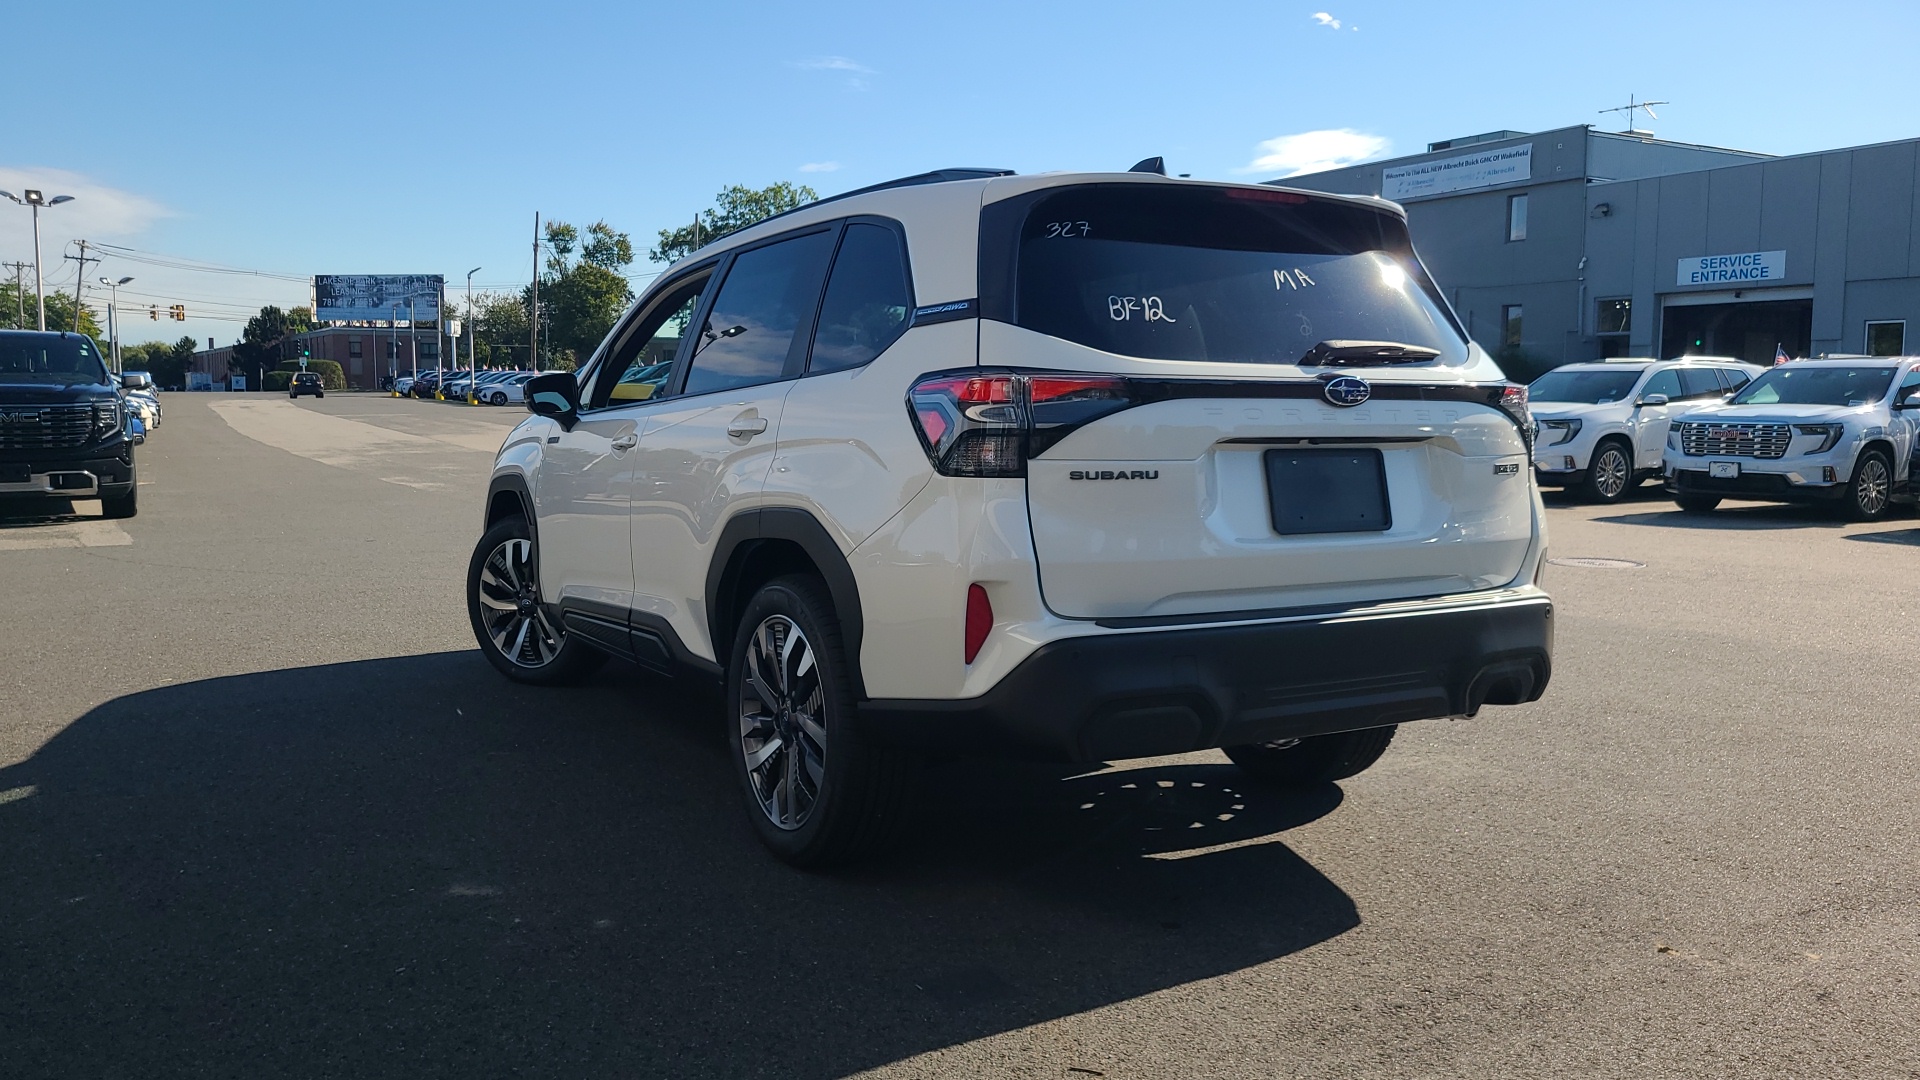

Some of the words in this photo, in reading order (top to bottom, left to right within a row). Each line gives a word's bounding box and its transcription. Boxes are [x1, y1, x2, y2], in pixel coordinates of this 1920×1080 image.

[1430, 164, 1443, 172] NEW
[1442, 162, 1464, 171] Albrecht
[1465, 158, 1479, 167] Buick
[1480, 155, 1493, 164] GMC
[1500, 149, 1529, 160] Wakefield
[1487, 166, 1515, 176] Albrecht
[1045, 221, 1092, 239] 327
[1700, 254, 1762, 269] SERVICE
[1274, 268, 1315, 290] MA
[1691, 266, 1769, 282] ENTRANCE
[0, 412, 38, 422] MC
[1202, 407, 1460, 423] FORESTER
[1711, 427, 1750, 439] GMC
[1069, 470, 1159, 480] SUBARU
